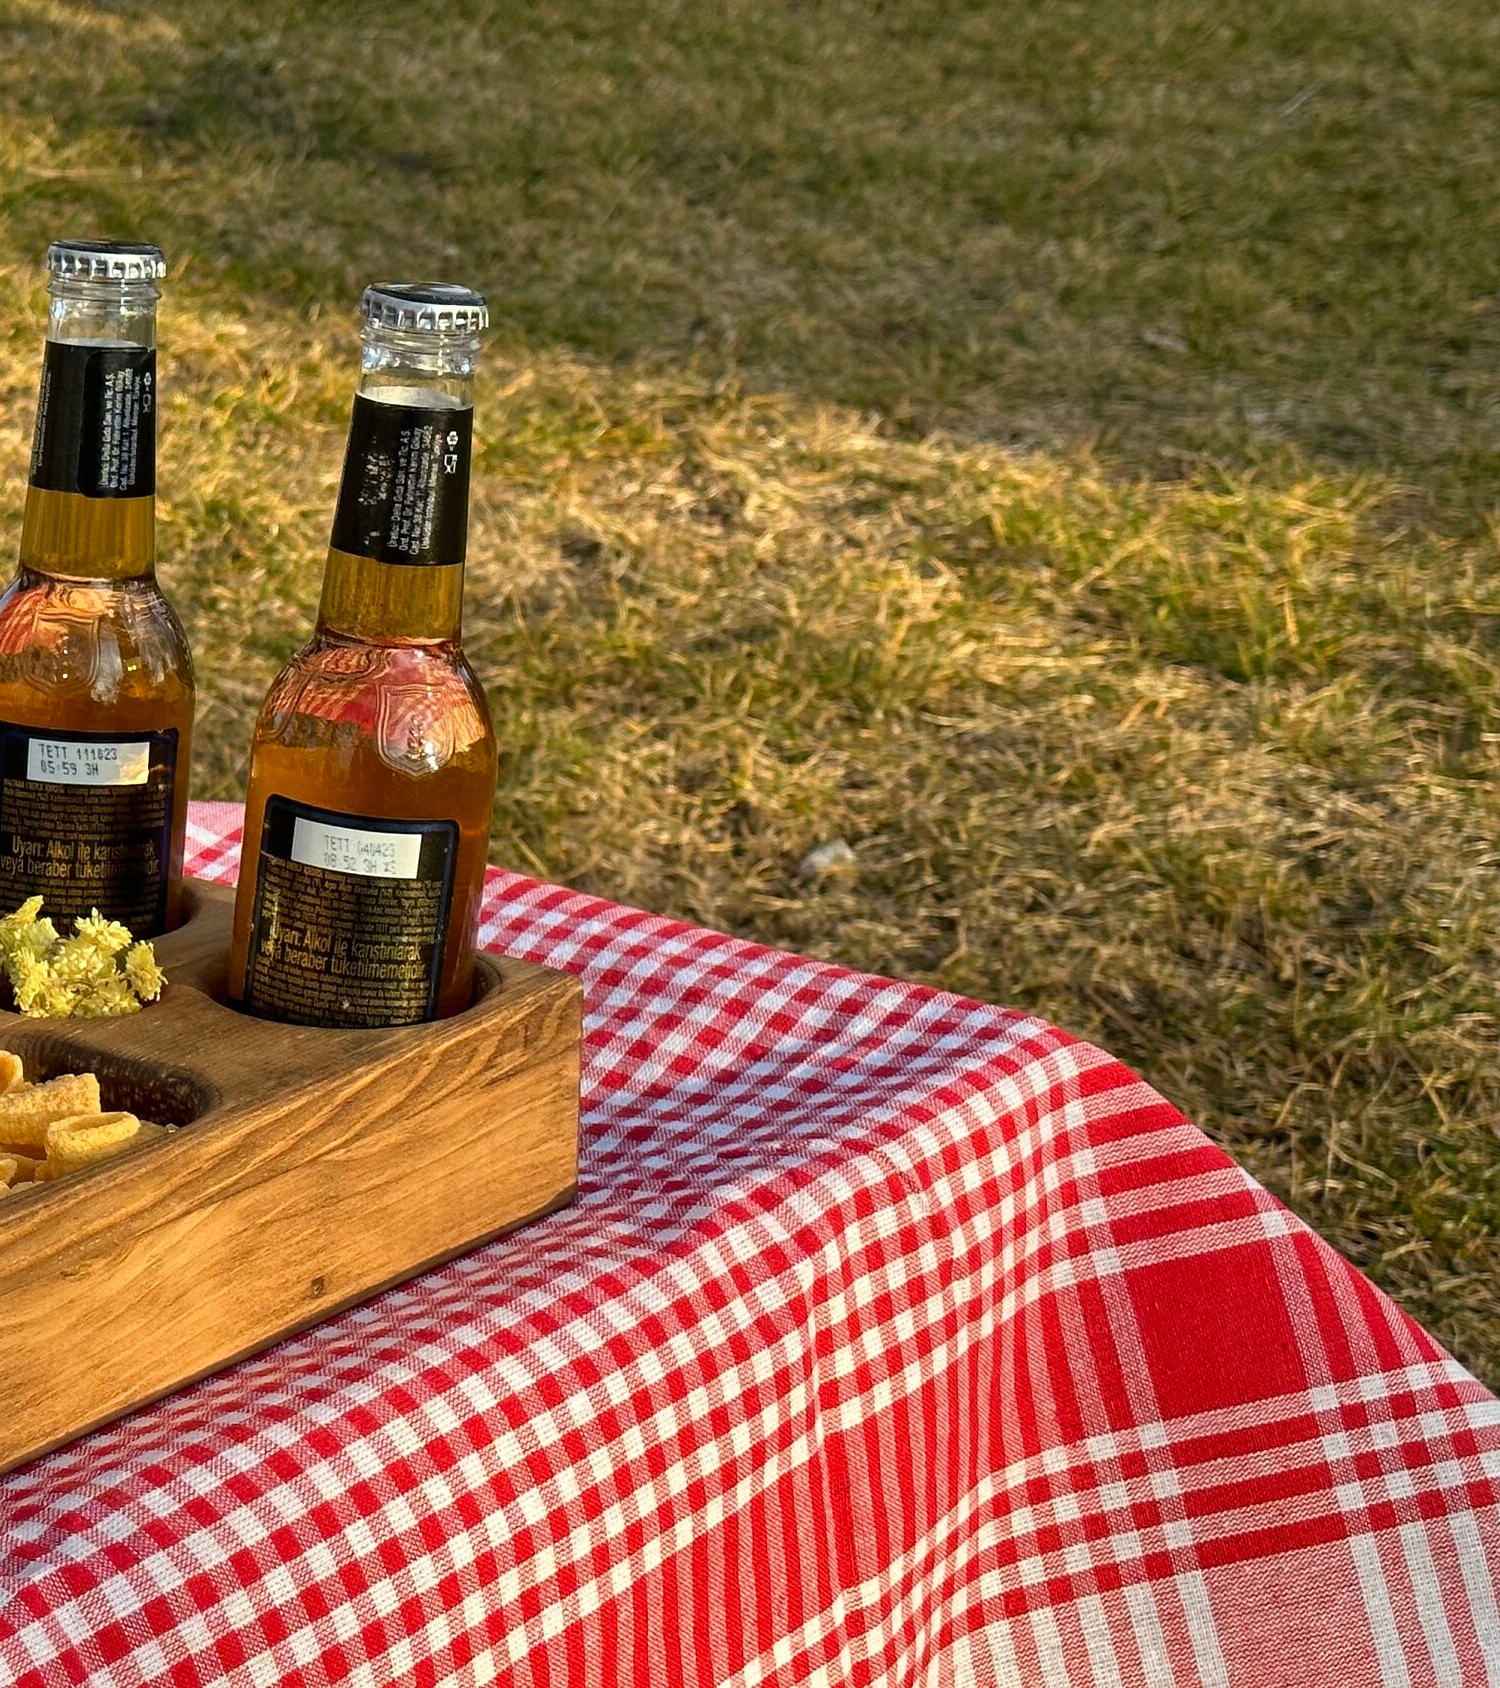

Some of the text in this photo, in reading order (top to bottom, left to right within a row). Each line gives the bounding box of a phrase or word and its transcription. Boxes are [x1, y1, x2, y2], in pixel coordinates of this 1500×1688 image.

[38, 744, 117, 760] TETT 111023
[85, 763, 98, 775] 3H
[46, 841, 75, 860] Alkol
[77, 843, 91, 860] ile
[324, 835, 350, 851] TETT
[27, 857, 71, 877] beraber
[303, 925, 331, 953] Alkol
[334, 936, 348, 956] ile
[284, 945, 328, 971] beraber
